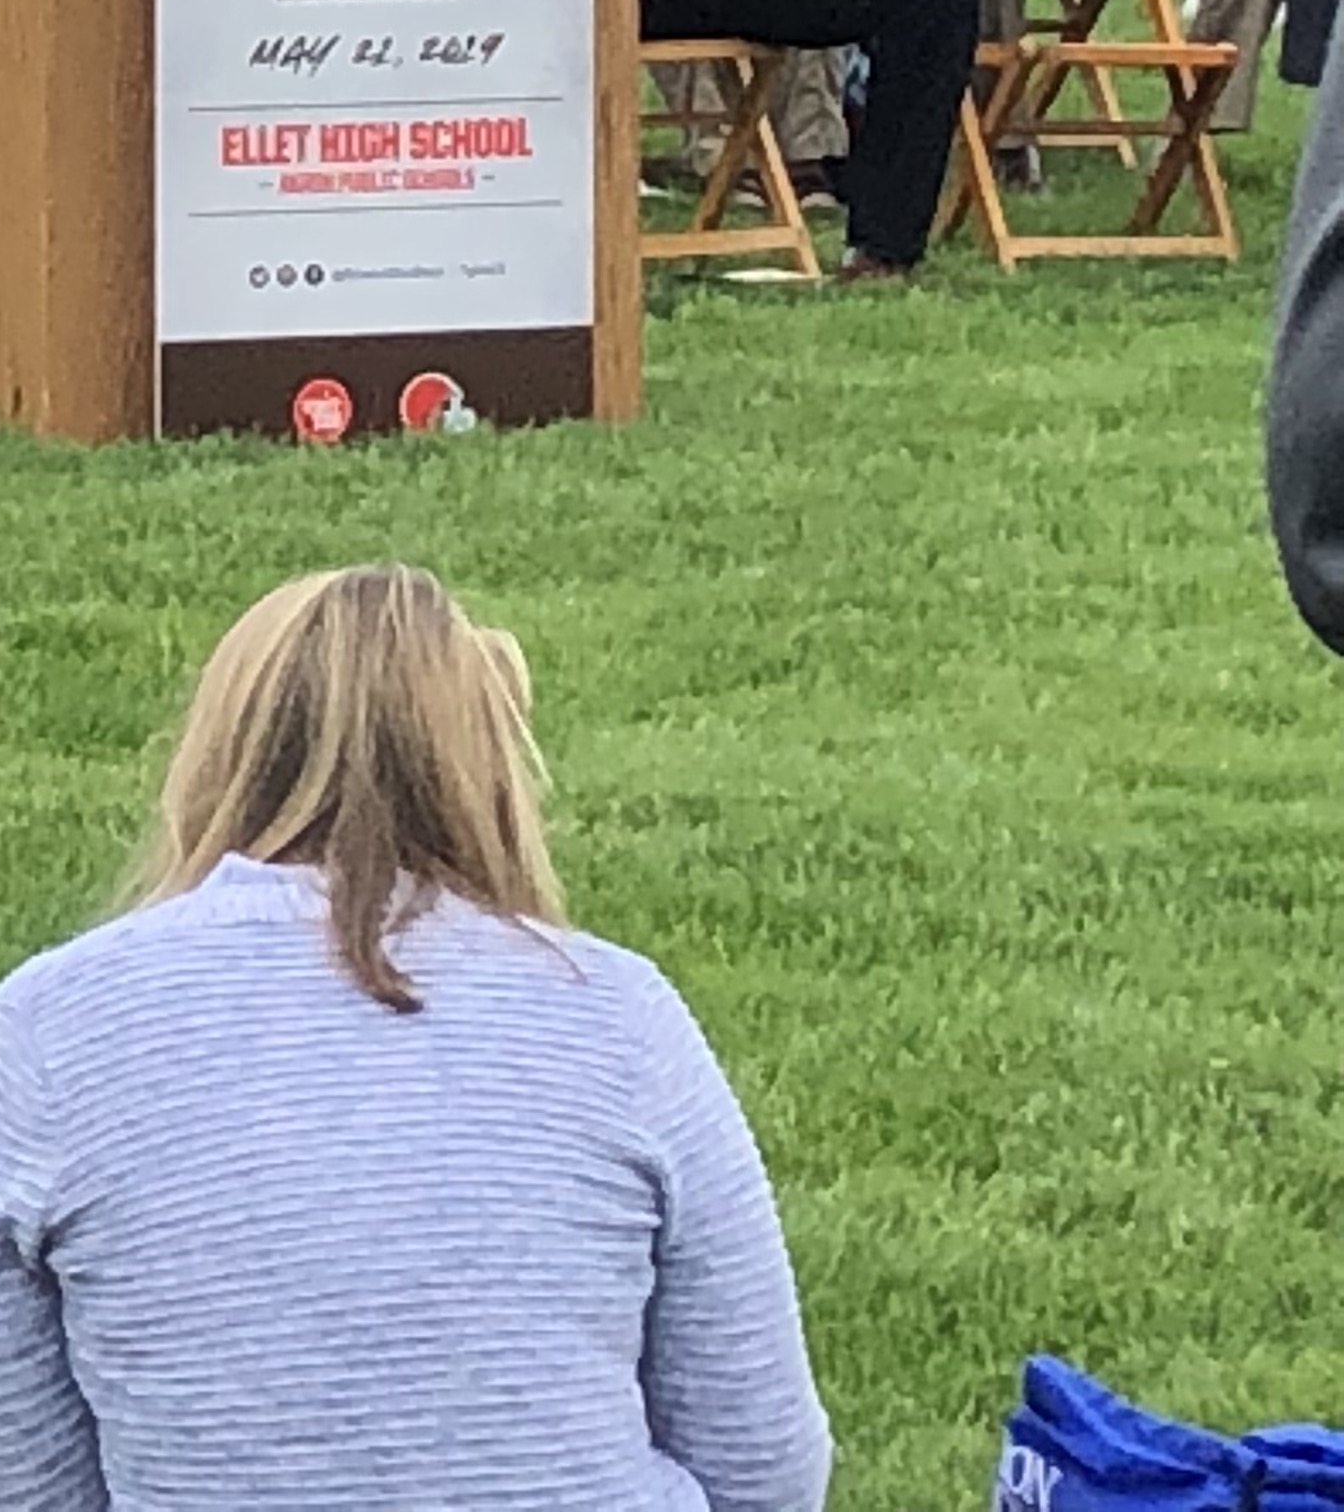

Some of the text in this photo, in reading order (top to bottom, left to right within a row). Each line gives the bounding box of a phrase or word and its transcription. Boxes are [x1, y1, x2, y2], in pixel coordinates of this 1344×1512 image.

[248, 33, 342, 78] MAY
[418, 31, 506, 67] 2019
[221, 117, 533, 166] ELLET HIGH SCHOOL
